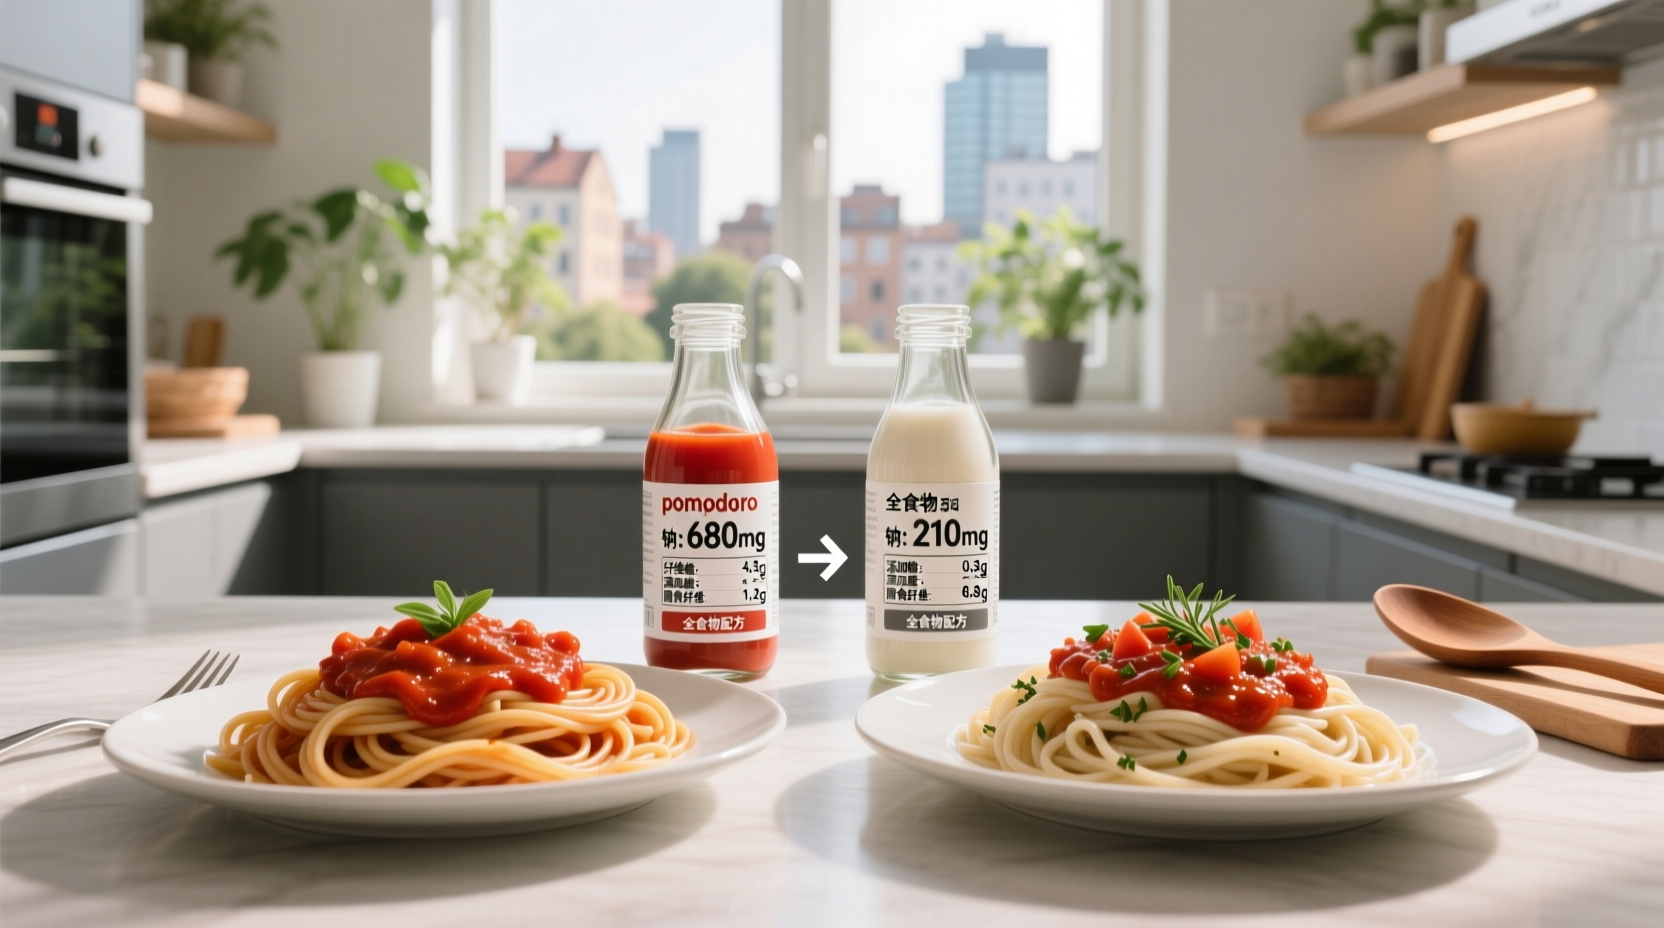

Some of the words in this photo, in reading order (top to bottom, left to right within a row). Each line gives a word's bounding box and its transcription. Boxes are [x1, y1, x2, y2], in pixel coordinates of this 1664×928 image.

[662, 492, 758, 516] pomodoro
[687, 521, 766, 552] 680mg
[912, 519, 988, 551] 210mg
